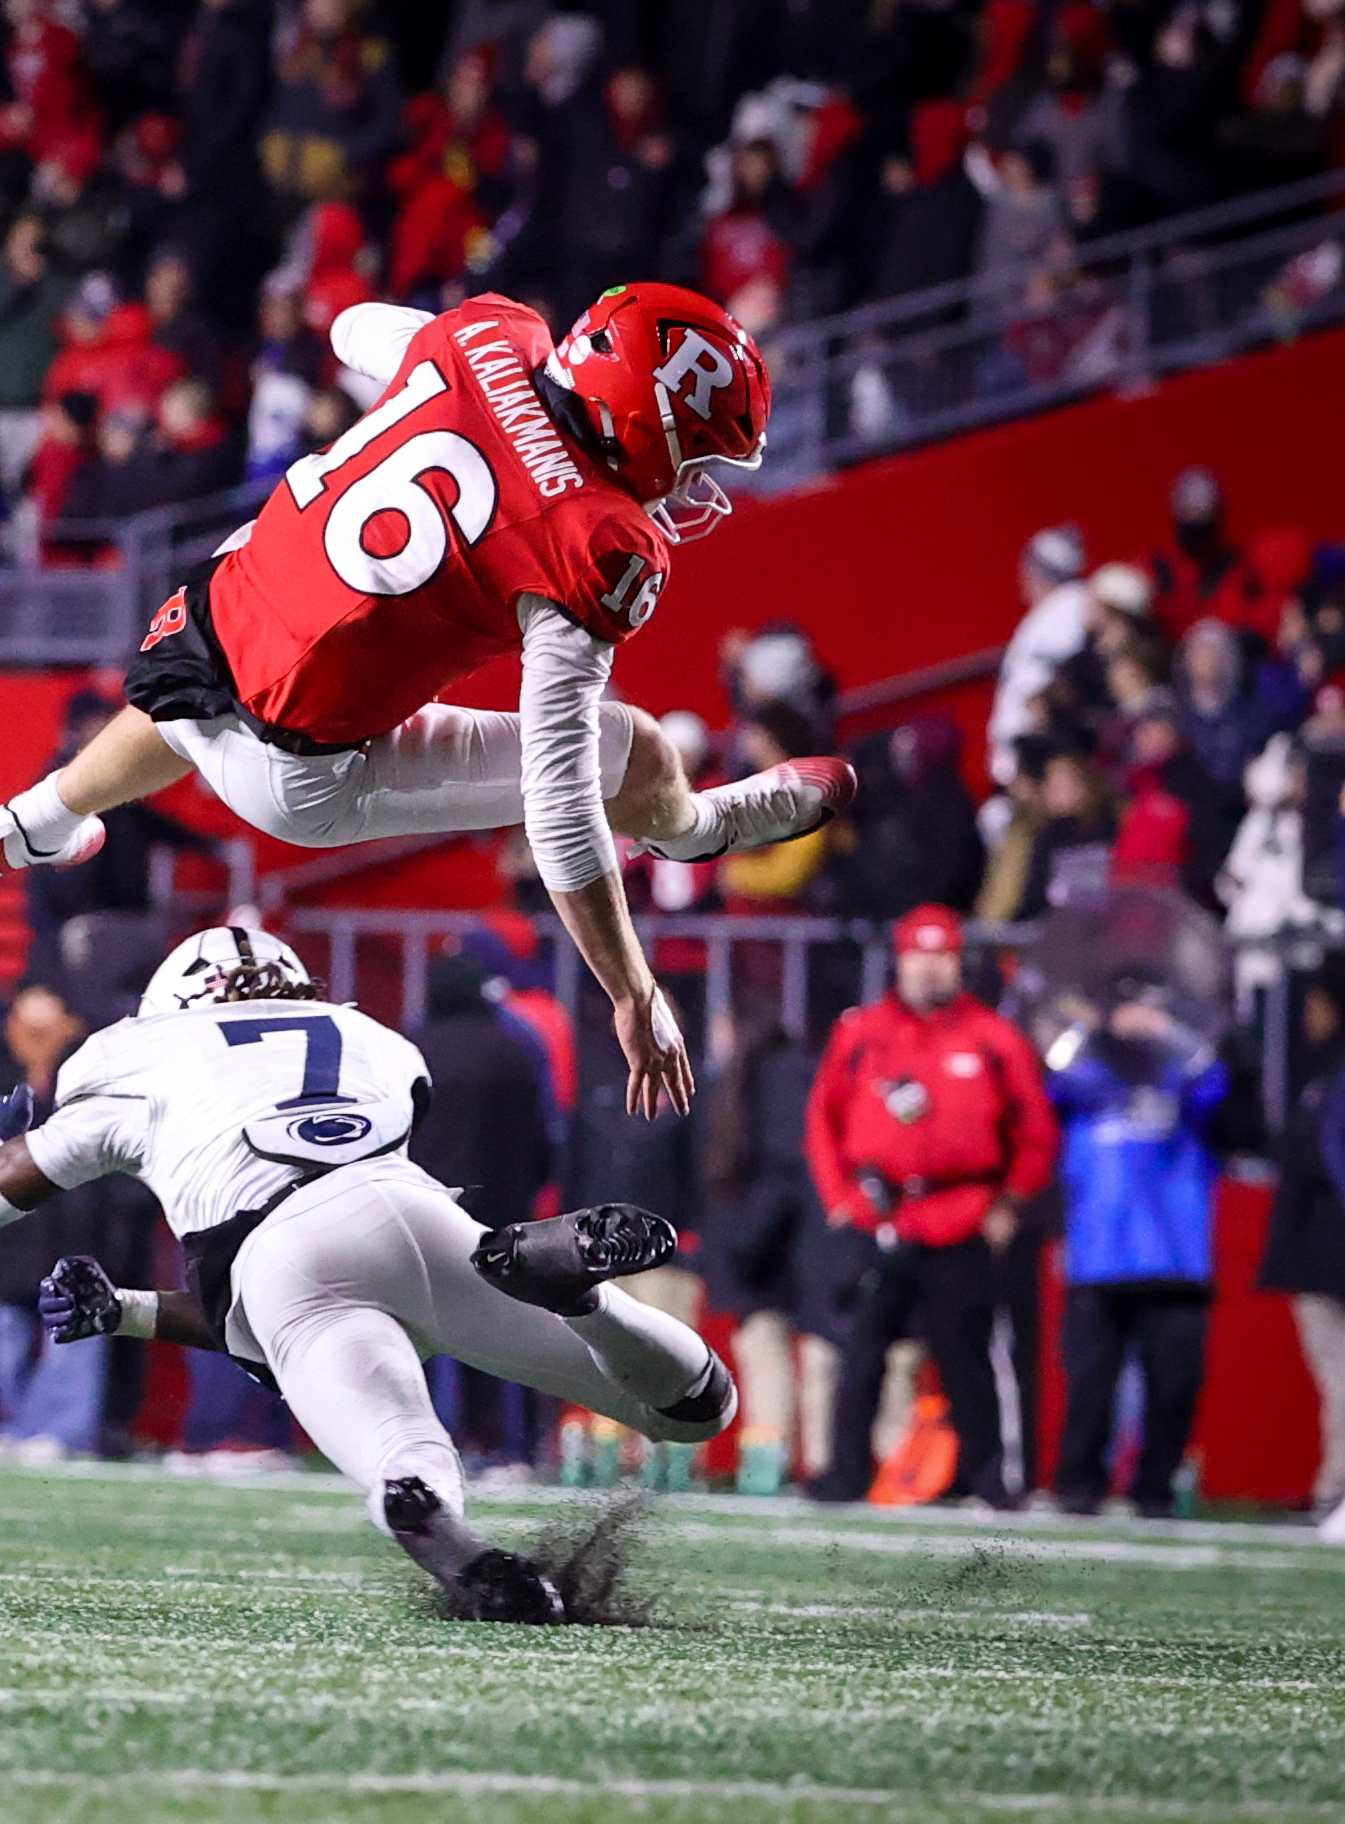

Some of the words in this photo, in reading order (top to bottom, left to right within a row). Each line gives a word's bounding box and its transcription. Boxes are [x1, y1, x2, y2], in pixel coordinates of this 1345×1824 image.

[453, 319, 501, 348] A.
[652, 327, 733, 421] R
[463, 339, 585, 498] KALIAKMANIS
[284, 359, 499, 596] 16
[139, 585, 187, 652] R
[600, 554, 663, 627] 16
[215, 1014, 359, 1111] 7
